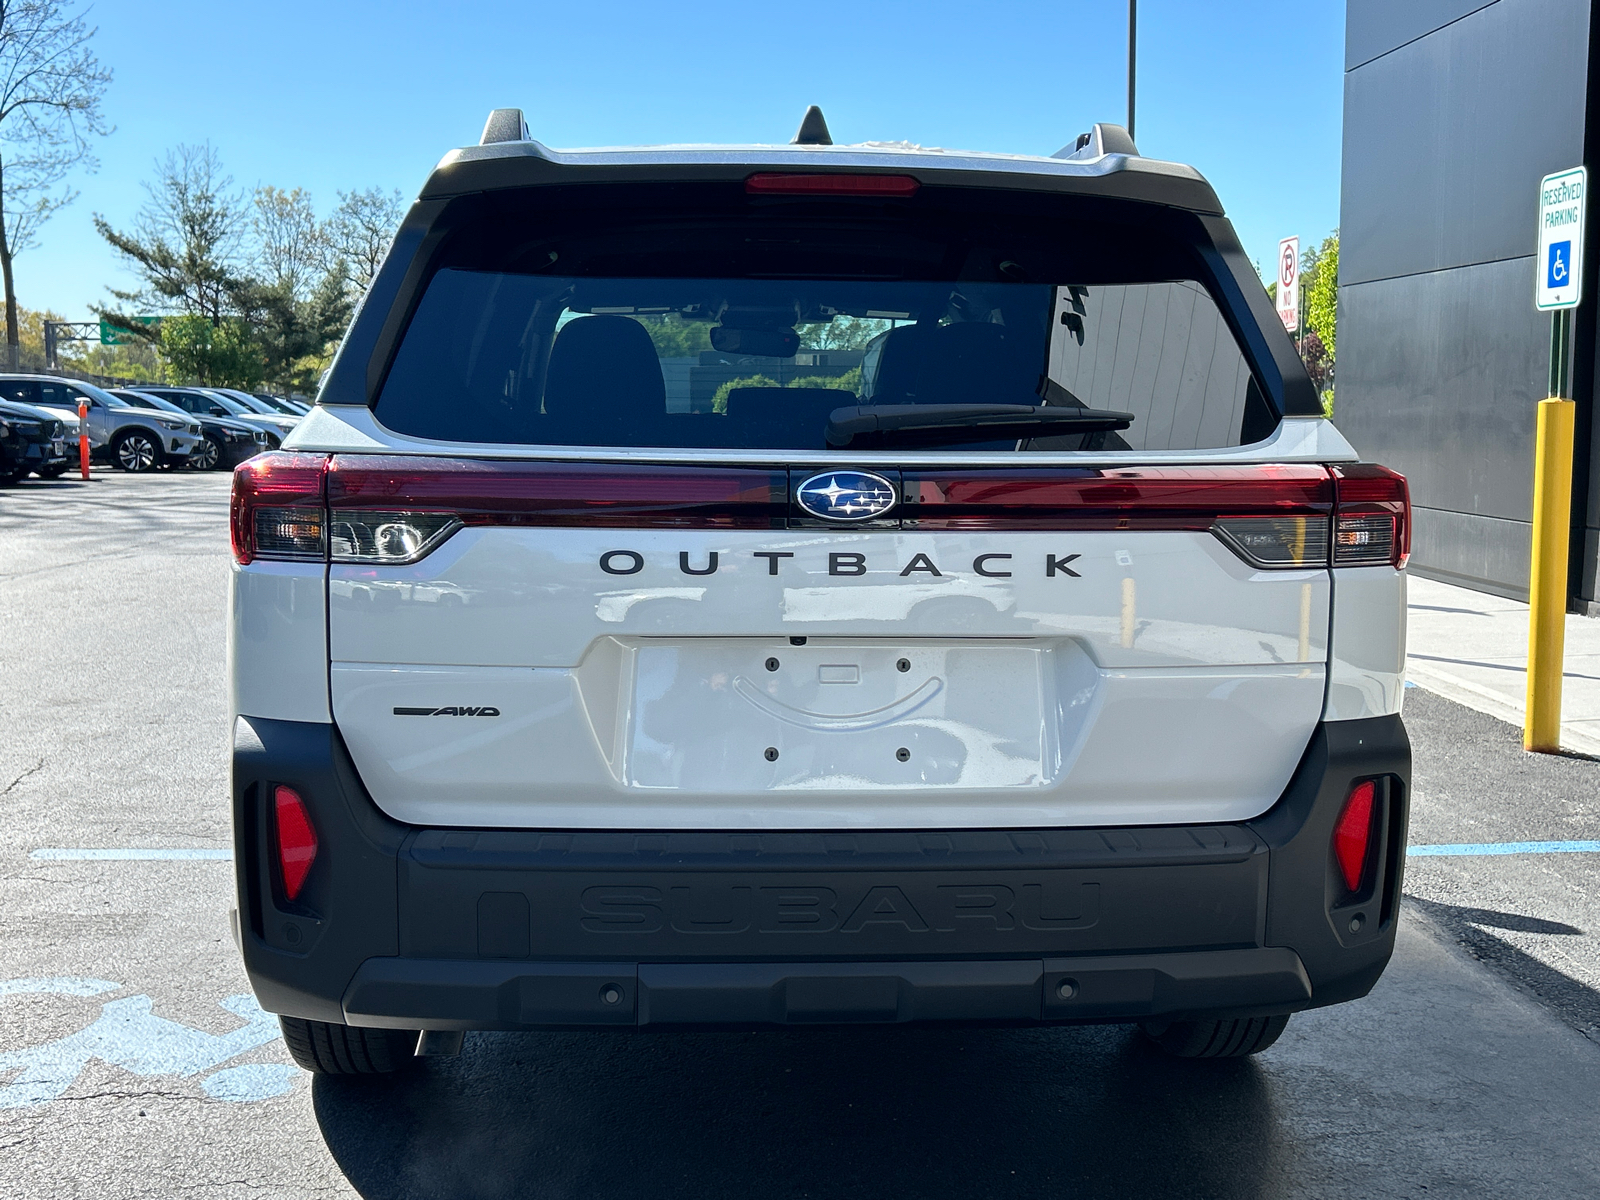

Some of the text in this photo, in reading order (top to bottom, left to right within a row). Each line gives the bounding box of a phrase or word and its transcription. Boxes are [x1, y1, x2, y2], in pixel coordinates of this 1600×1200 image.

[1544, 182, 1581, 207] RESERVED
[1545, 206, 1578, 229] PARKING
[1283, 290, 1292, 307] NO
[599, 549, 1082, 577] OUTBACK
[432, 706, 501, 717] AWD
[580, 883, 1101, 934] SUBARU
